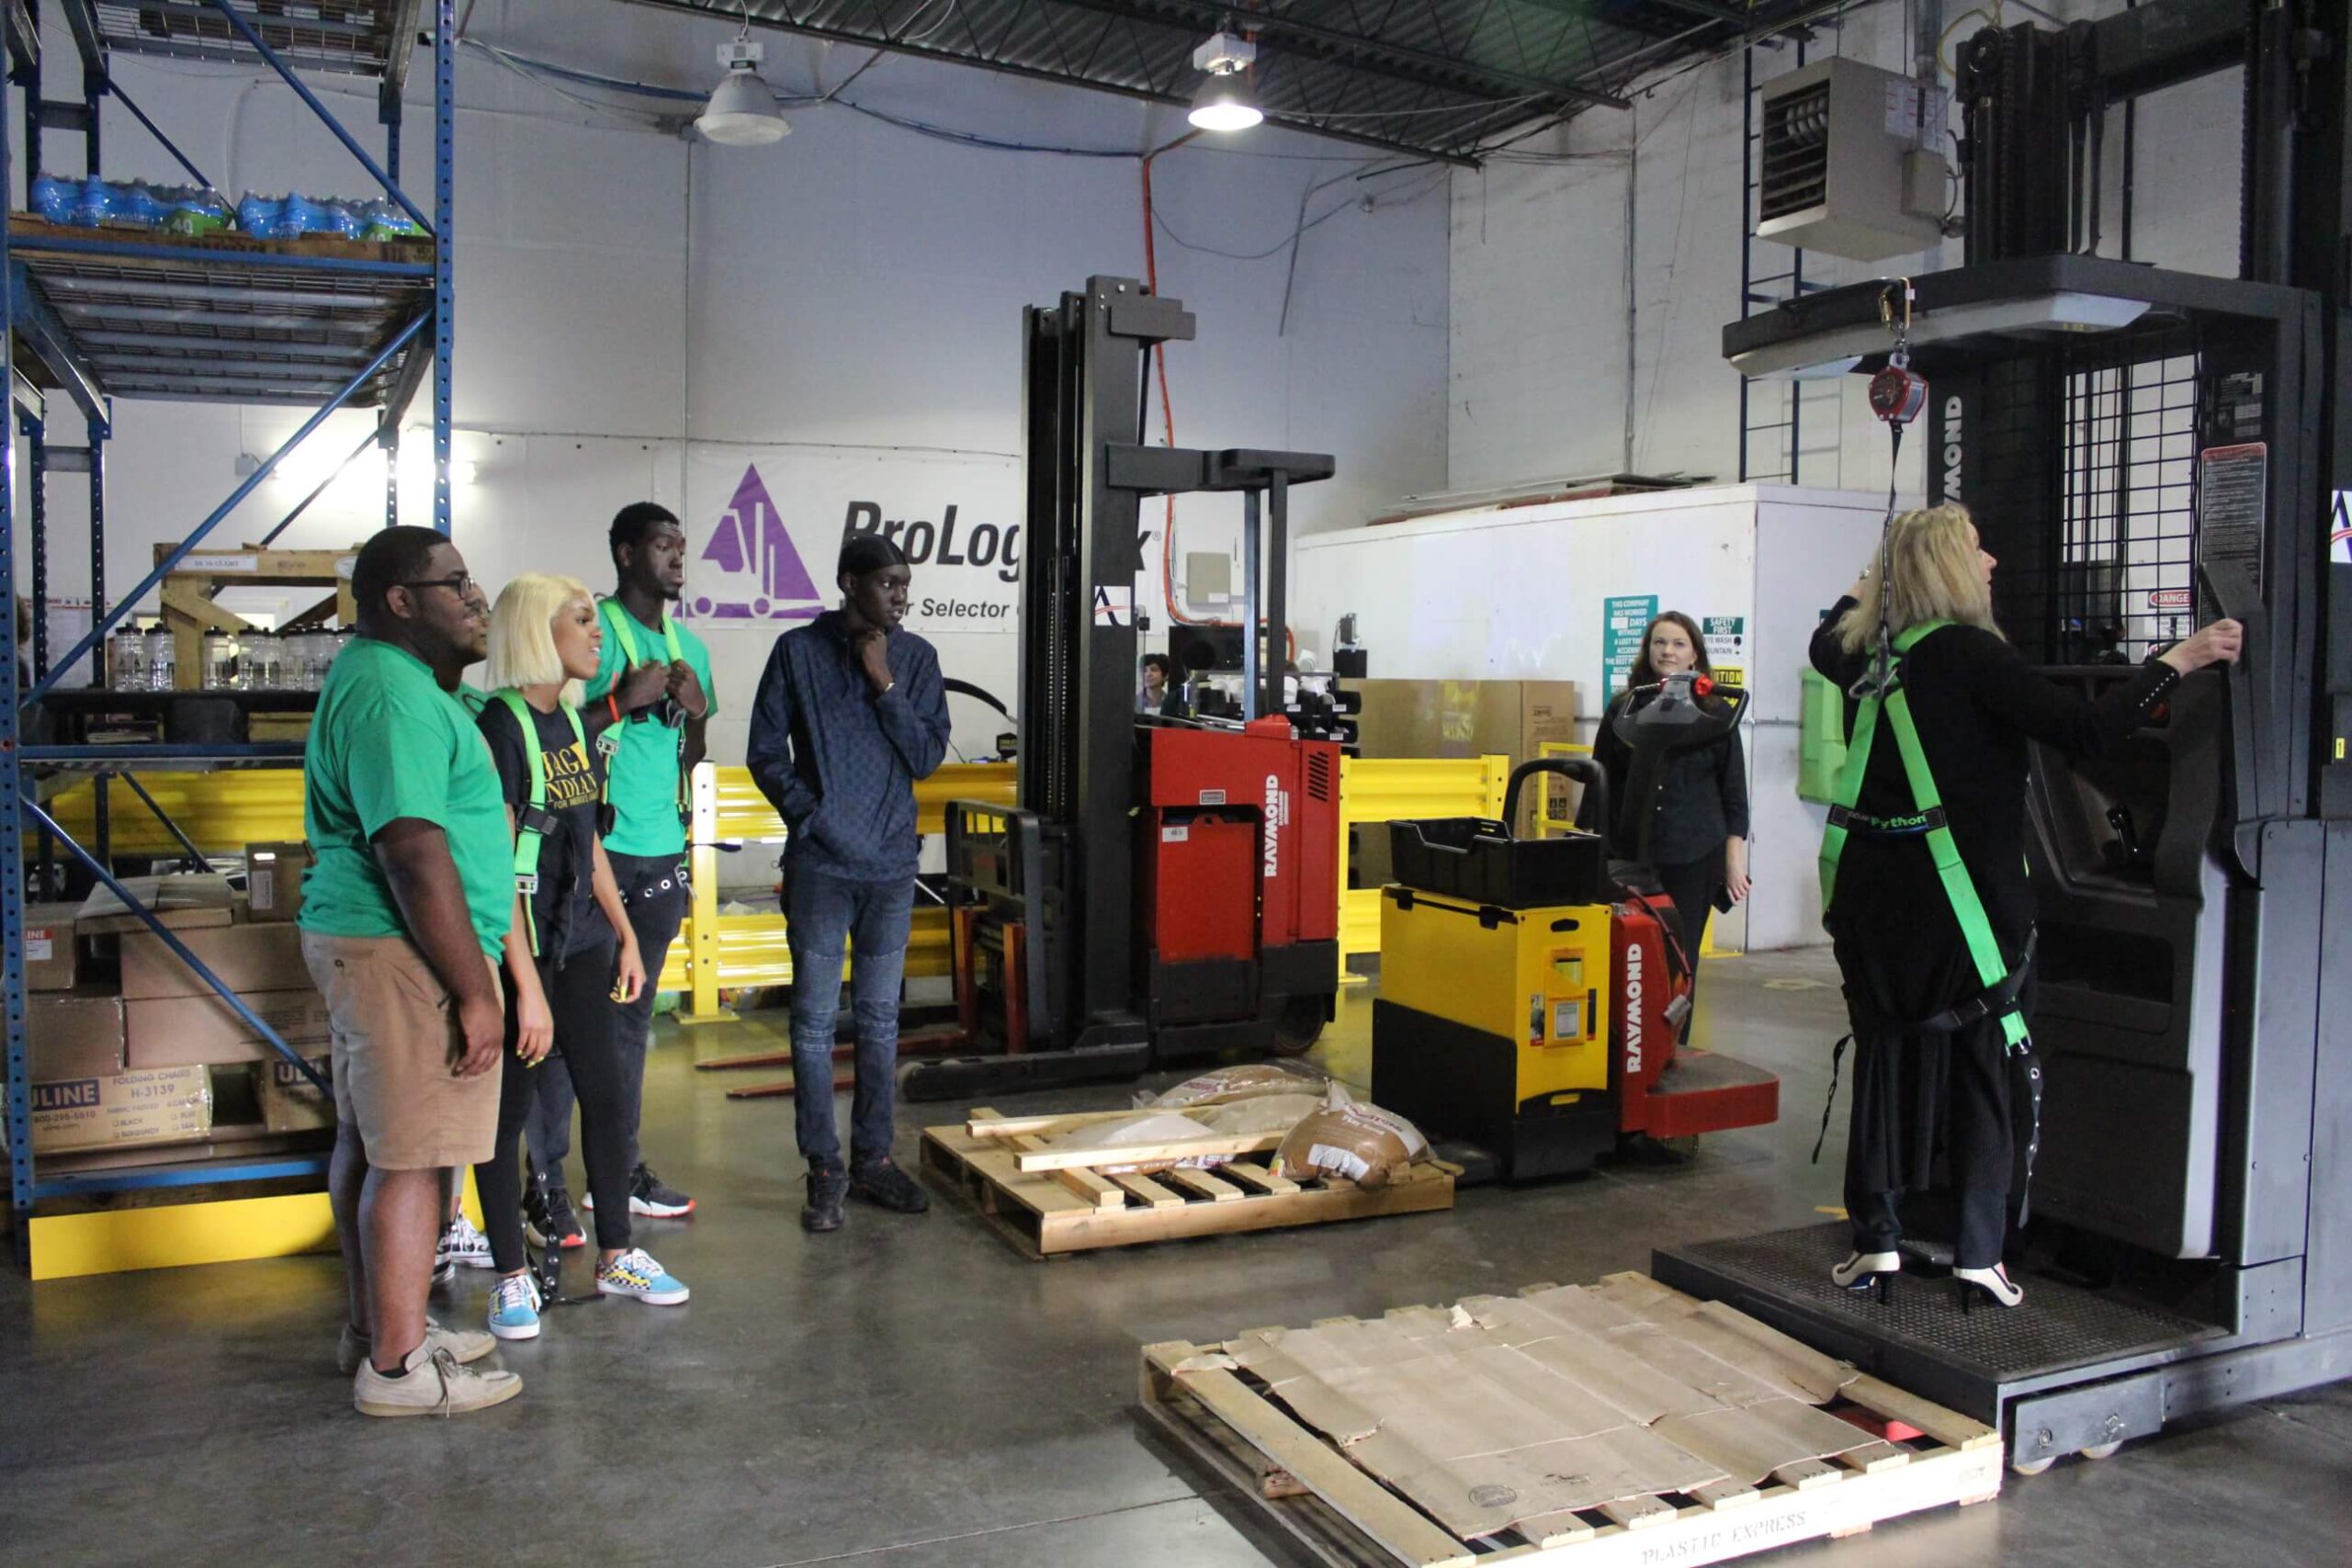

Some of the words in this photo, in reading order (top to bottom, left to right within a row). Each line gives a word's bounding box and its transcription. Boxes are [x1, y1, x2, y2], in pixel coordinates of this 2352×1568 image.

[1944, 396, 1962, 505] MOND
[2154, 593, 2191, 604] DANGE
[921, 598, 1010, 618] Selector
[1629, 617, 1647, 626] DAYS
[1710, 617, 1736, 626] SAFETY
[545, 772, 597, 803] NDIAN
[1264, 774, 1278, 877] RAYMOND
[1871, 814, 1927, 829] Python
[1626, 943, 1642, 1073] RAYMOND
[112, 1073, 155, 1087] FOLDING
[130, 1084, 175, 1099] H-3139
[1641, 1532, 1721, 1565] PLASTIC
[1732, 1511, 1806, 1543] EXPRESS
